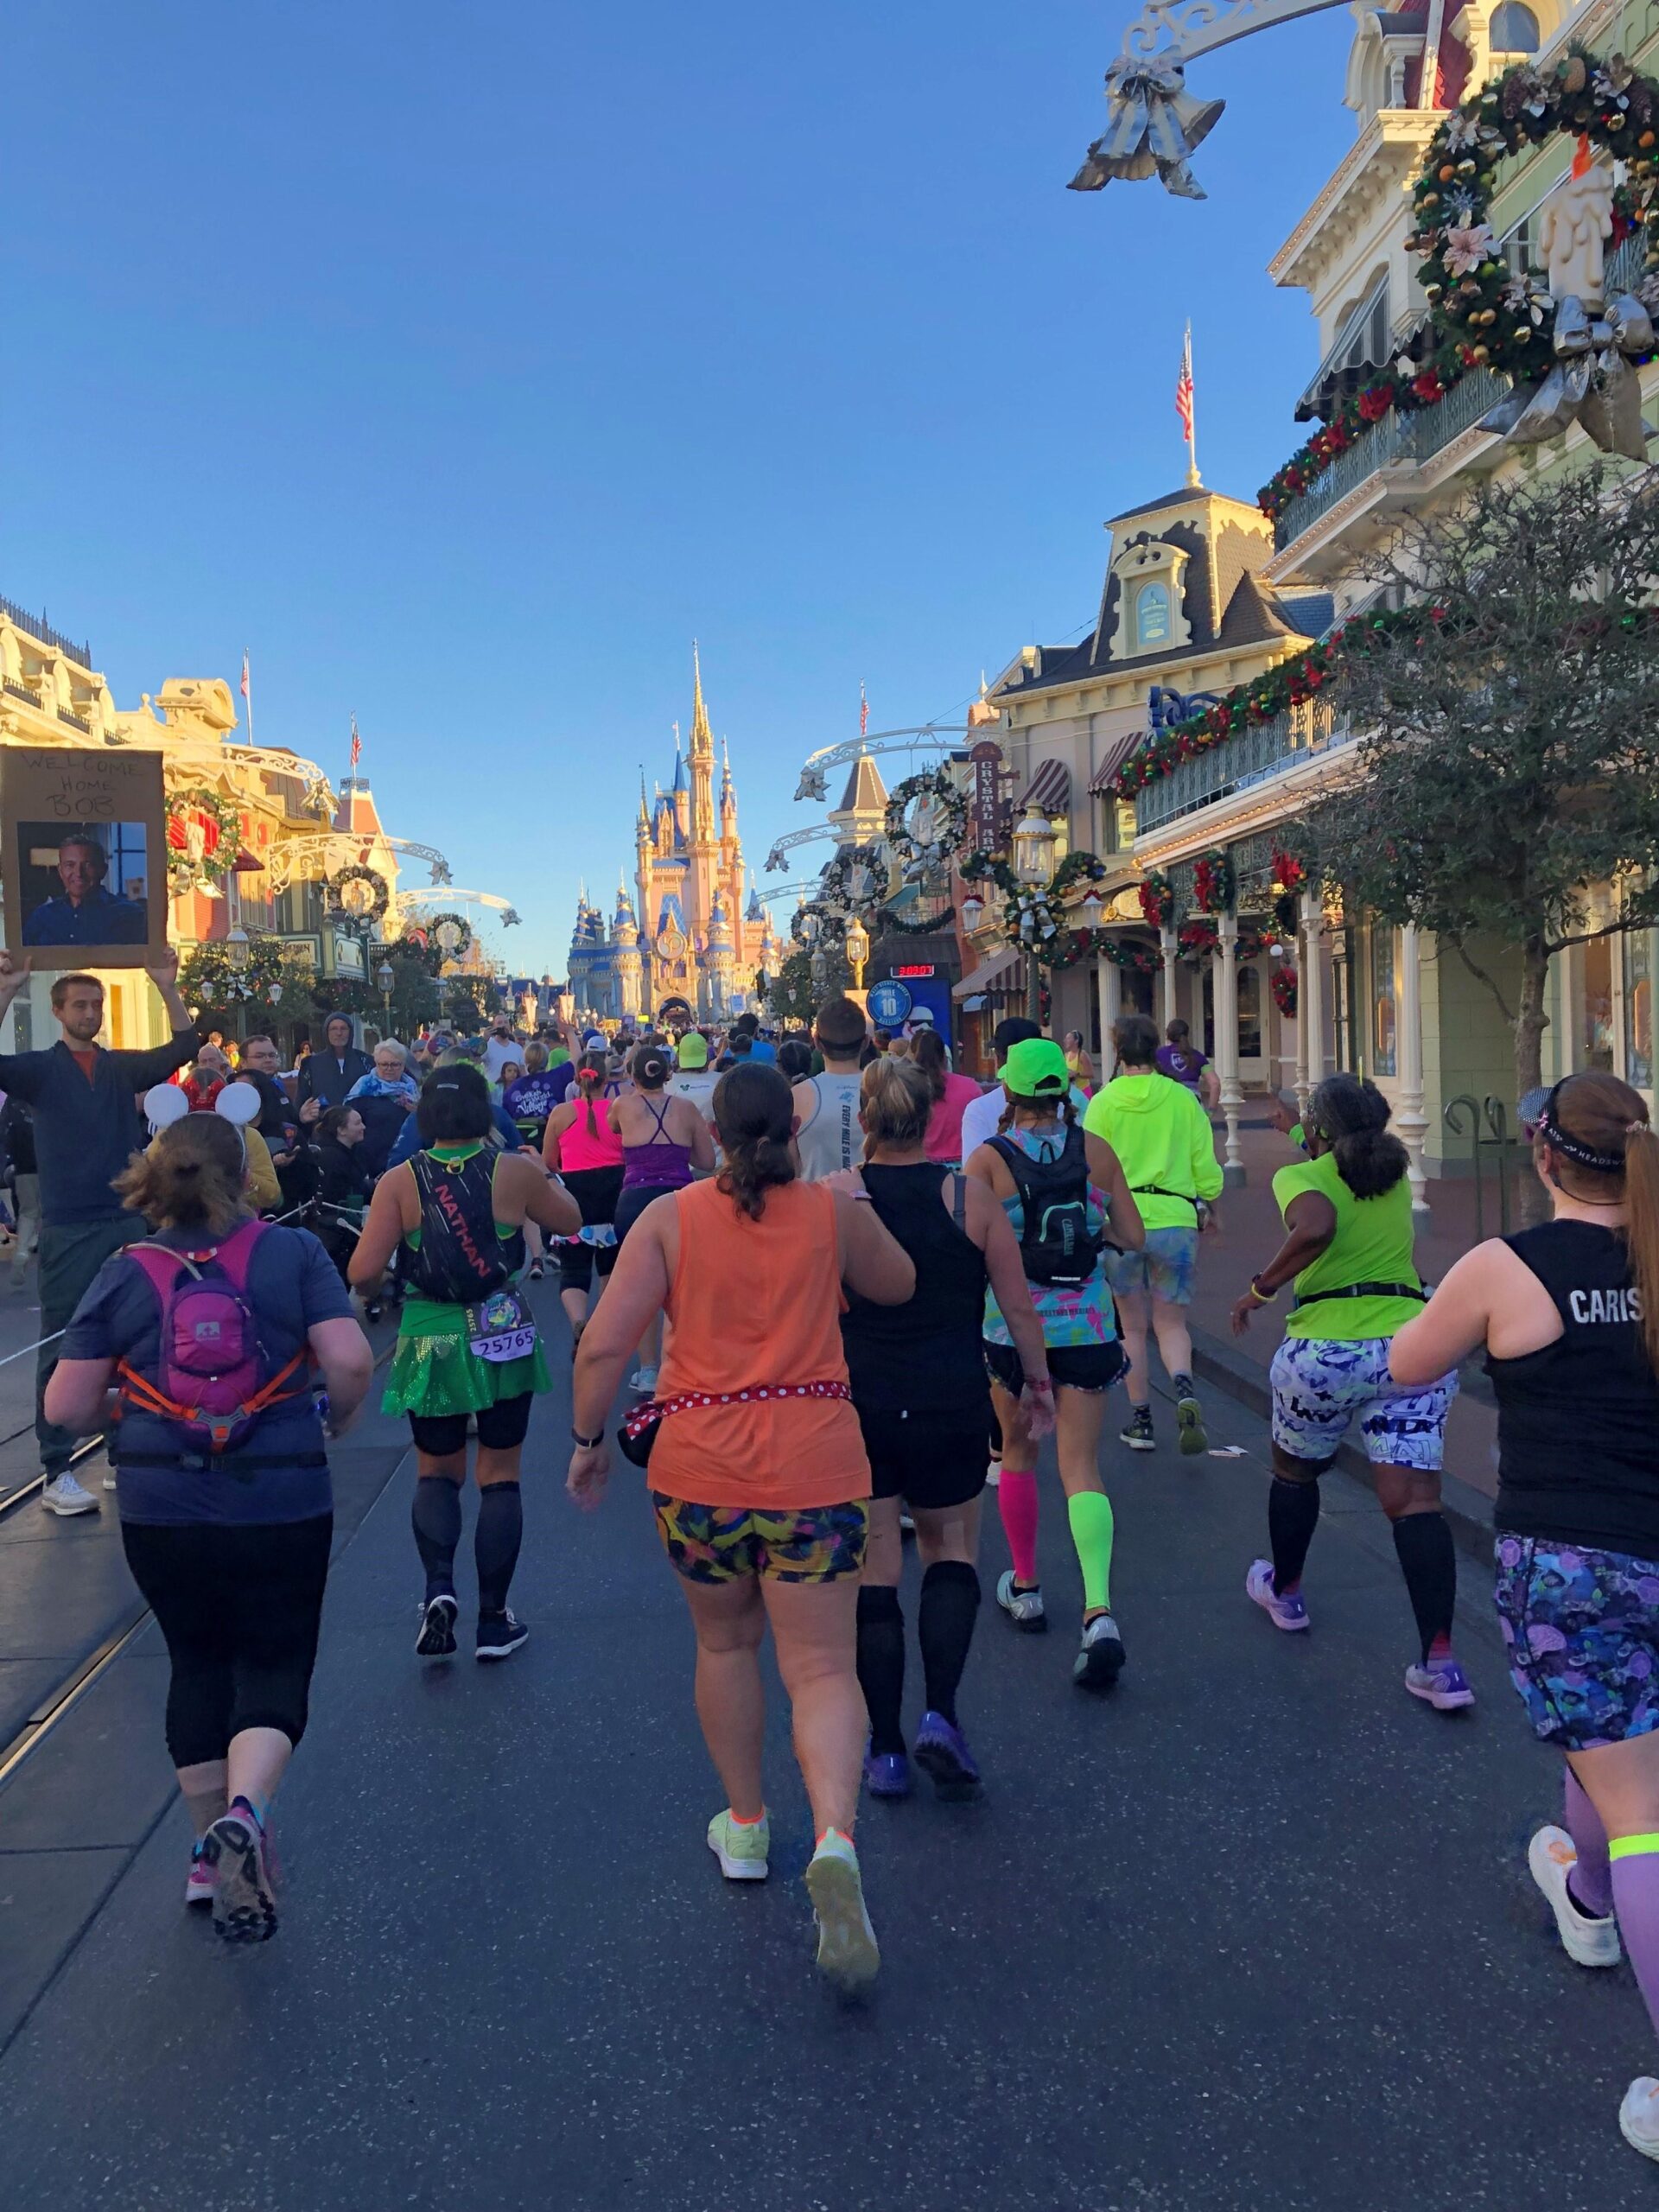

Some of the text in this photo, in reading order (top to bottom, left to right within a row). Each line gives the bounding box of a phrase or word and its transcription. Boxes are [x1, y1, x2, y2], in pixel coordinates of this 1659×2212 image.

[21, 752, 143, 776] WELCOME
[60, 776, 117, 791] HOME
[981, 761, 994, 820] CRYSTAL
[46, 794, 114, 817] BOB
[881, 998, 897, 1016] 10
[842, 1104, 851, 1128] EVERY
[842, 1128, 851, 1146] MILE
[842, 1147, 851, 1155] IS
[435, 1185, 491, 1277] NATHAN
[467, 1308, 477, 1332] 25765
[479, 1331, 533, 1355] 25765
